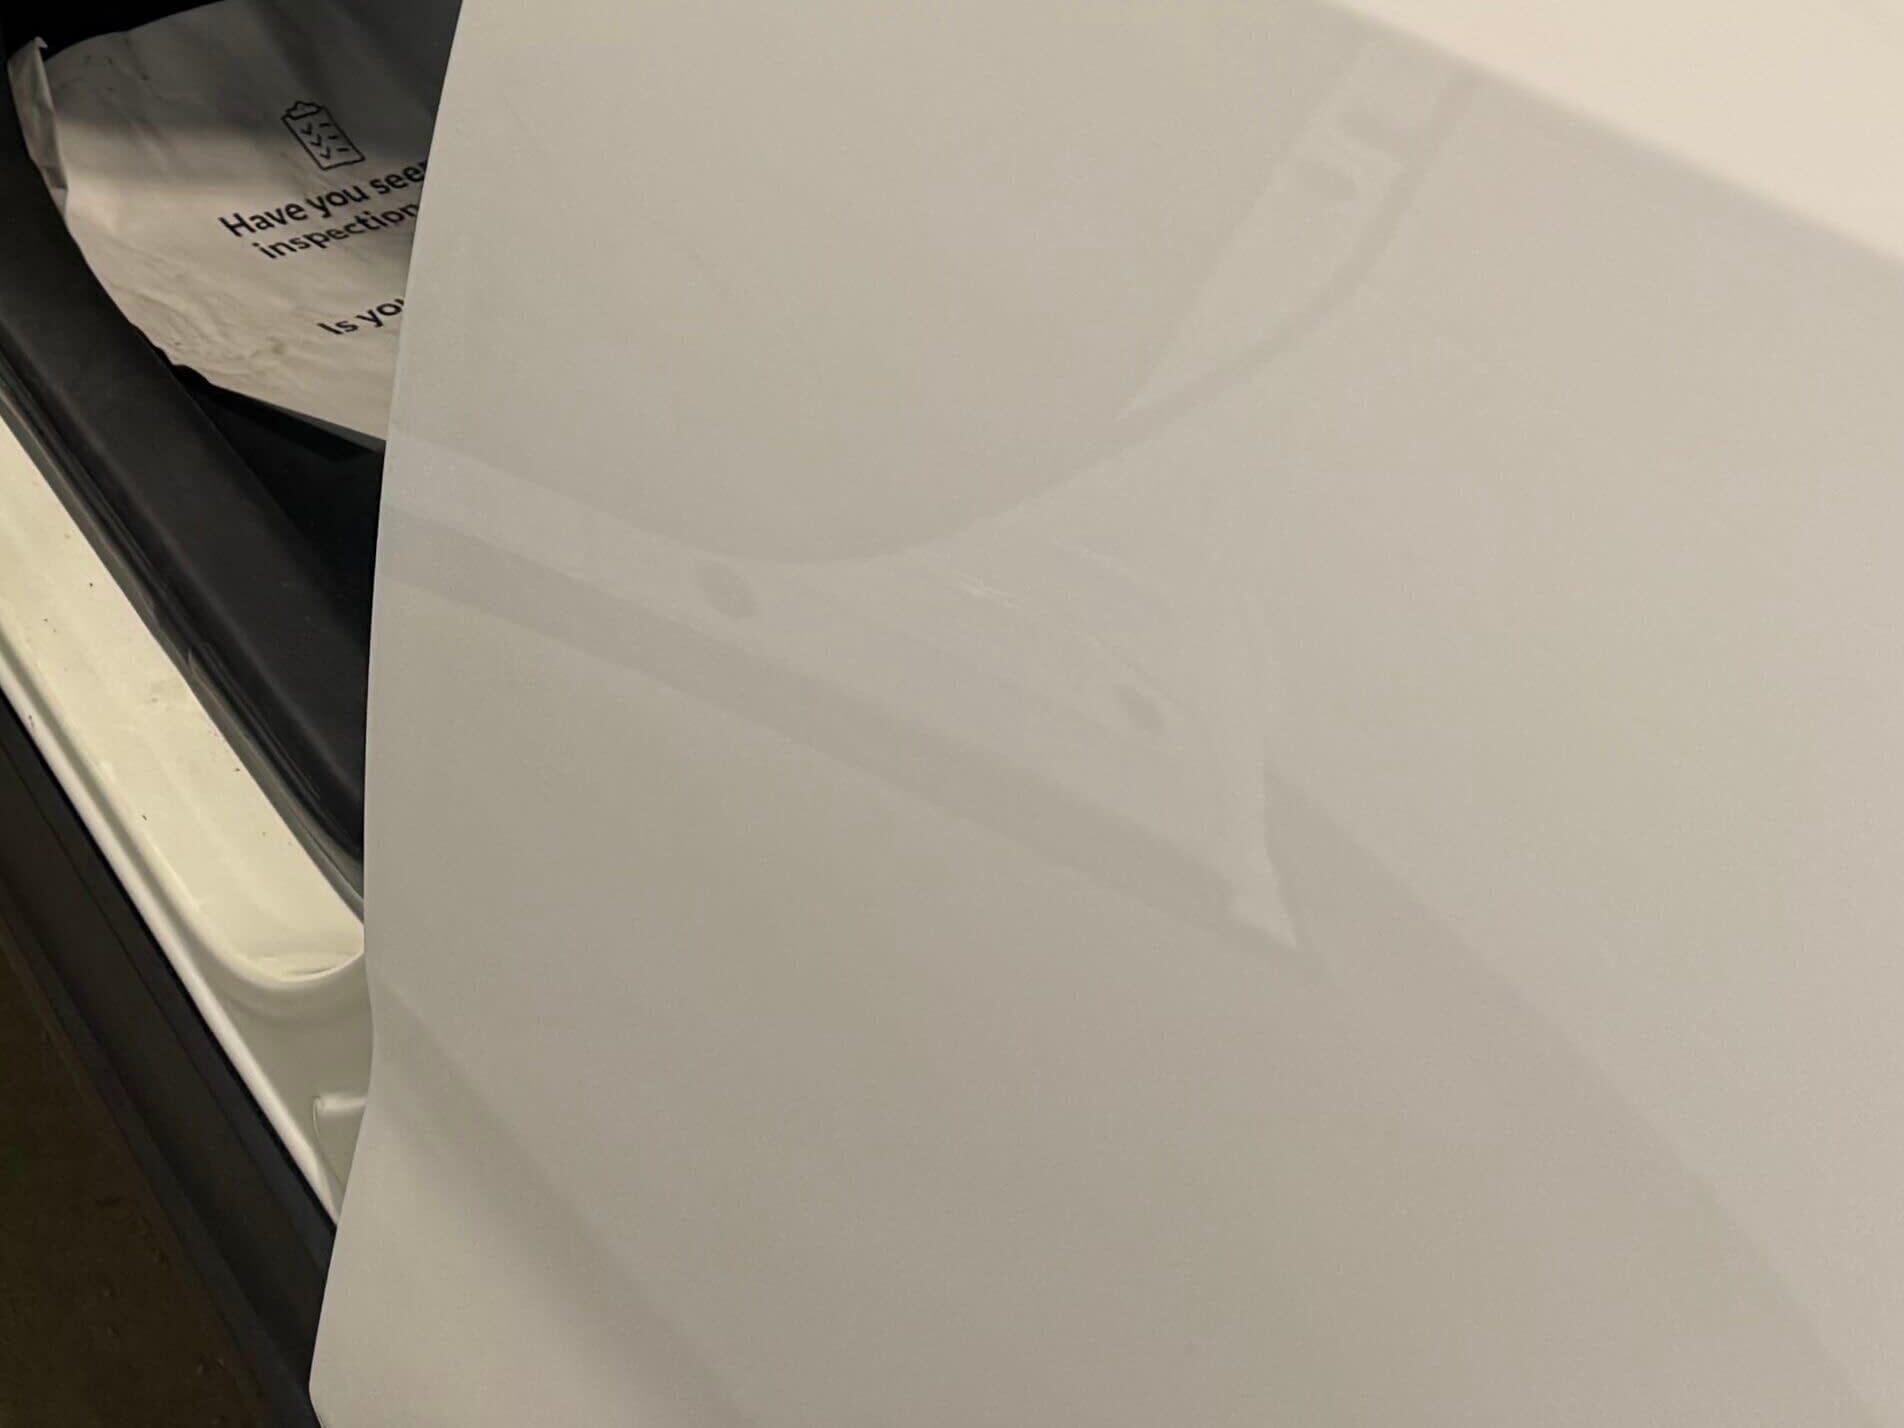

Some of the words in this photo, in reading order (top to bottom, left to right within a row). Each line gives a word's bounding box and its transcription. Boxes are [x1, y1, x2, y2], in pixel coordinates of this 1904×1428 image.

[218, 202, 308, 238] Have
[306, 185, 370, 218] you
[369, 161, 426, 195] see
[317, 319, 358, 335] Is
